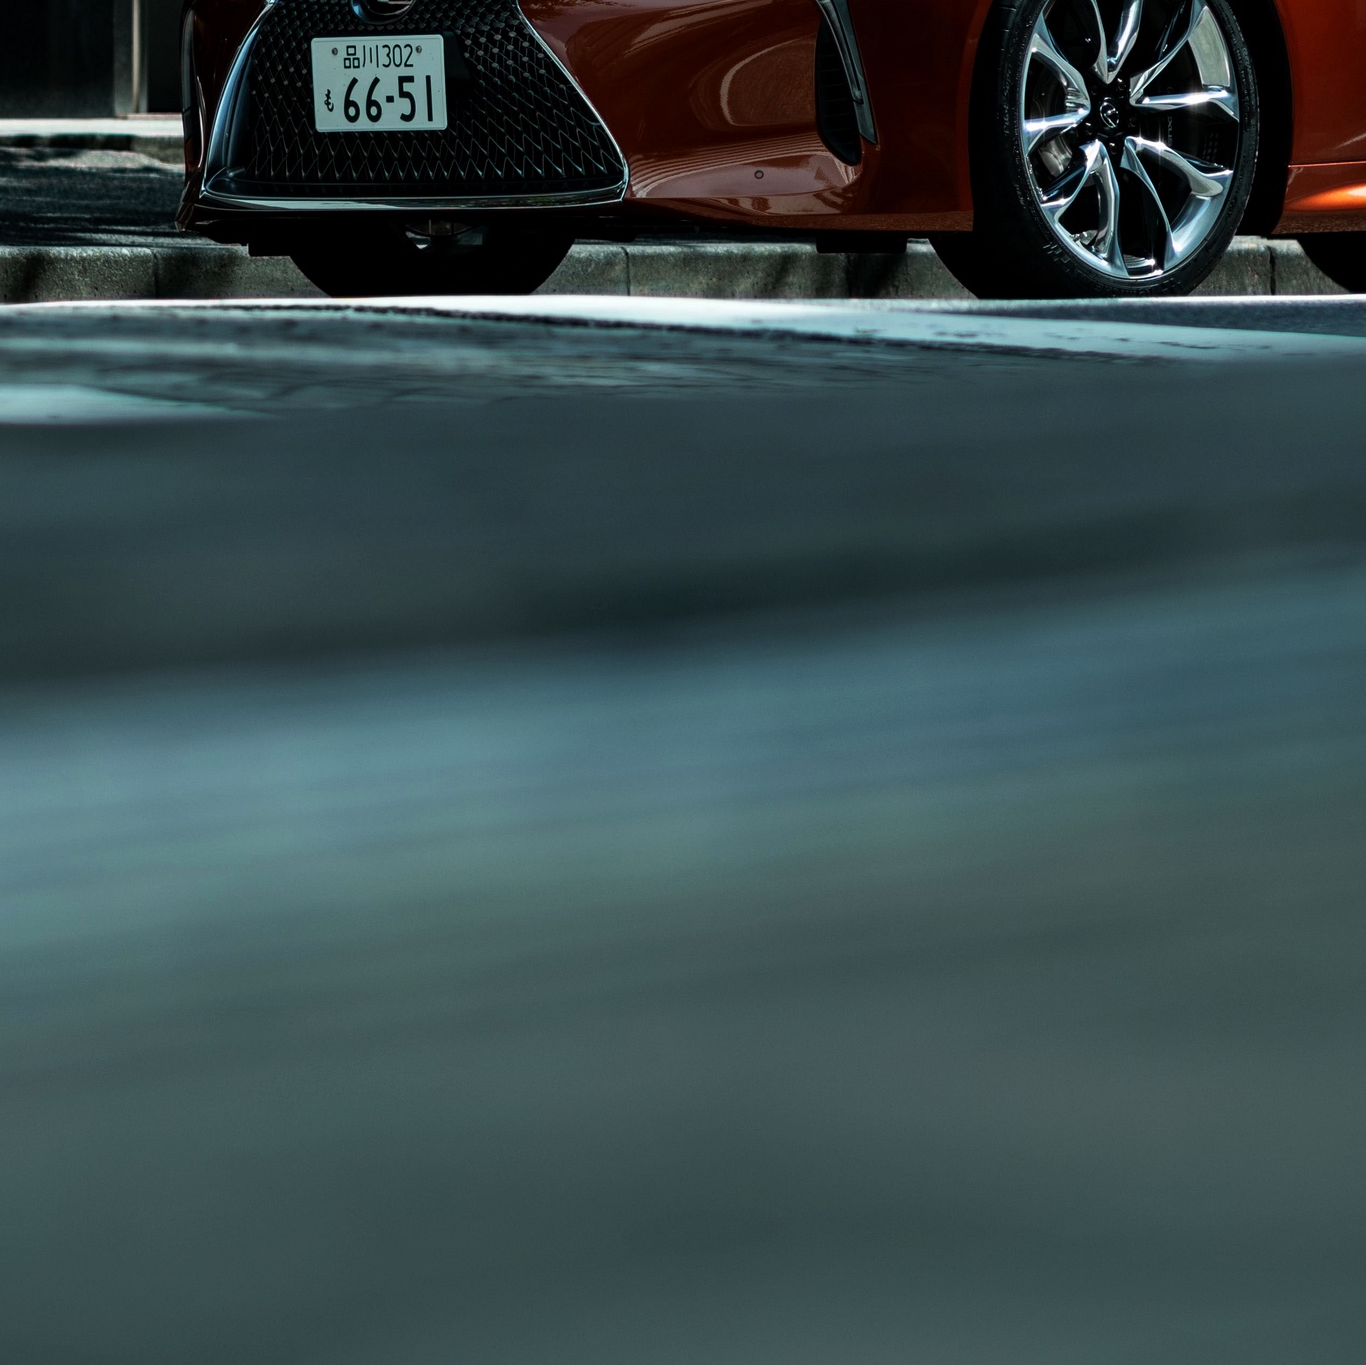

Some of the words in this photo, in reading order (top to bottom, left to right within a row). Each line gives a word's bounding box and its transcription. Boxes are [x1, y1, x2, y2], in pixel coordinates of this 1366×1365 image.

[343, 44, 414, 69] 品川302
[324, 89, 335, 112] も
[343, 75, 434, 123] 66-51
